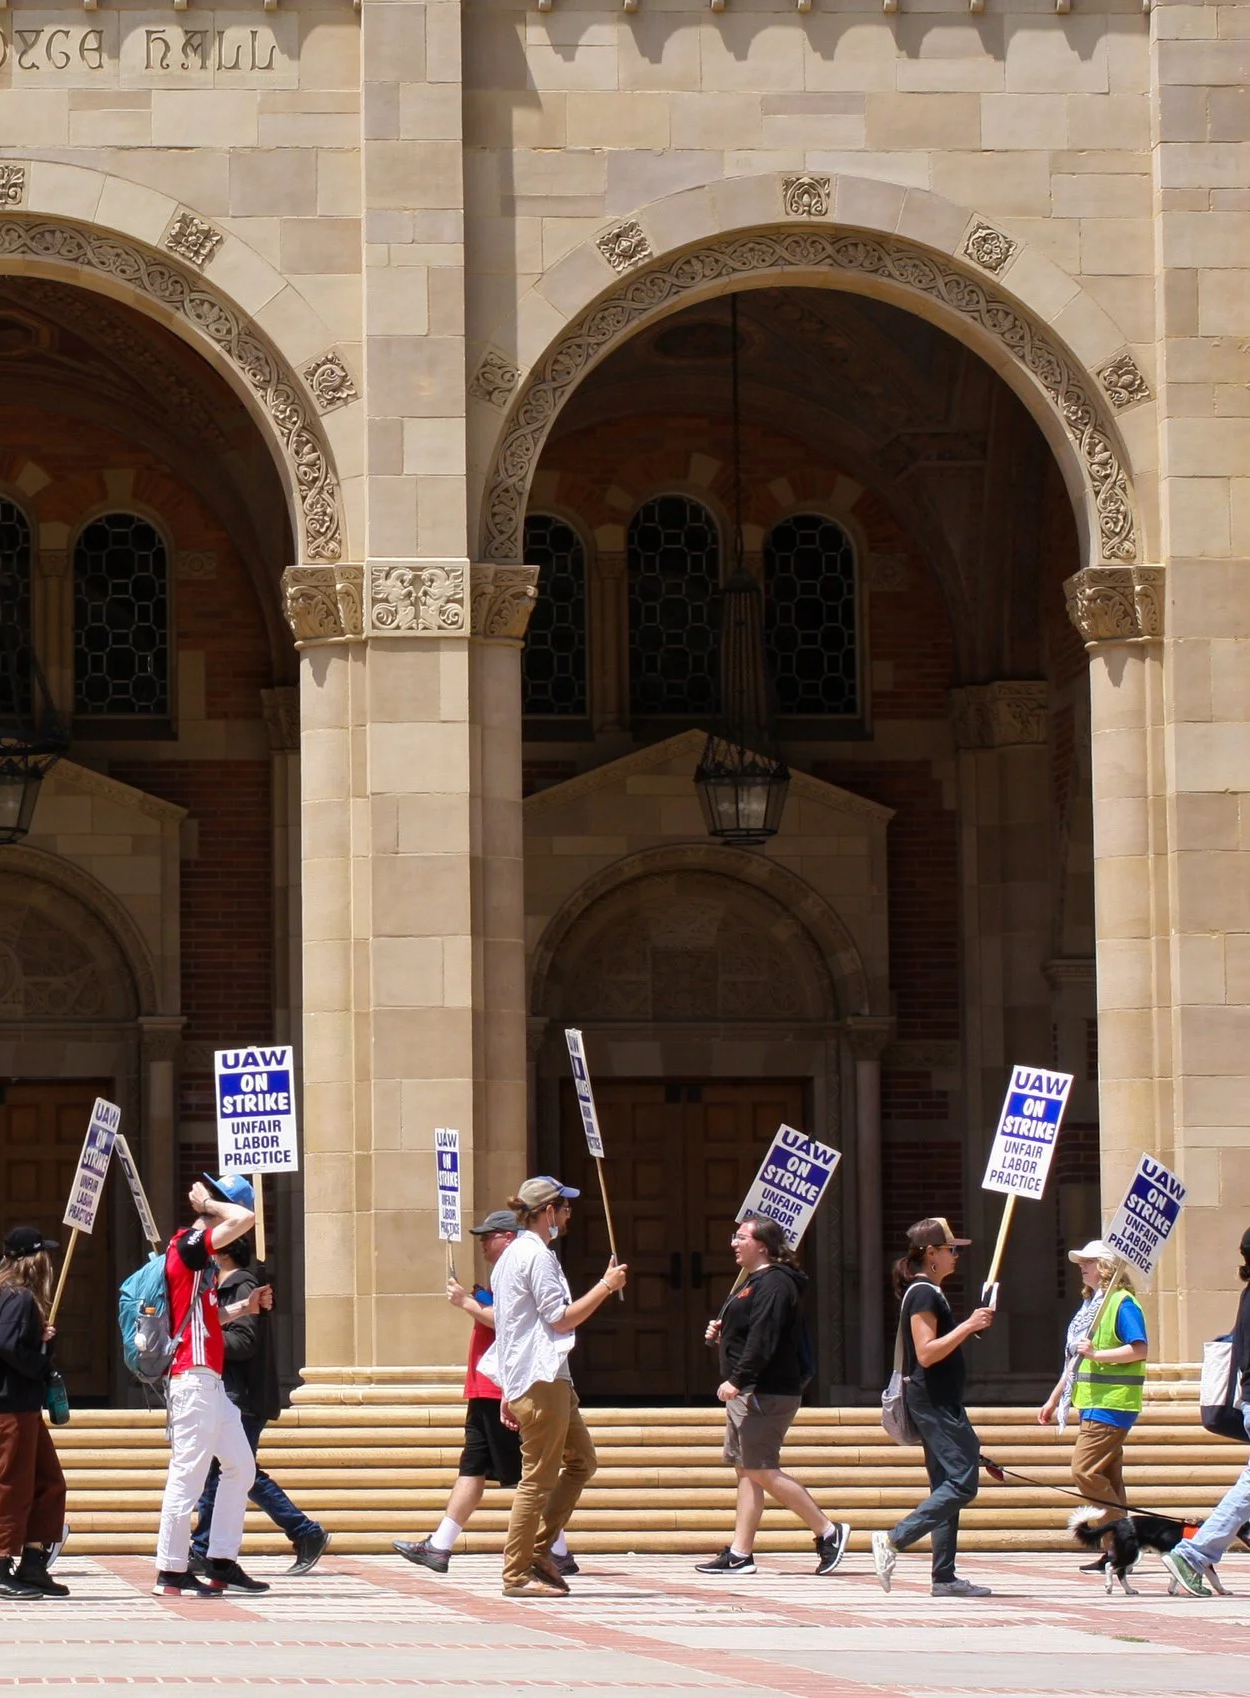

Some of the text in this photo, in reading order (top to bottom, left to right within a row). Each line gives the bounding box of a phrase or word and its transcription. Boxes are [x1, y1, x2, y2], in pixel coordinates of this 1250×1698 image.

[143, 26, 277, 71] HALL
[222, 1049, 287, 1069] UAW
[240, 1072, 268, 1093] ON
[1014, 1070, 1069, 1097] UAW
[95, 1102, 119, 1128] UAW
[222, 1092, 289, 1114] STRIKE
[1022, 1098, 1046, 1118] ON
[231, 1119, 282, 1135] UNFAIR
[1002, 1115, 1056, 1141] STRIKE
[95, 1129, 108, 1150] ON
[234, 1135, 280, 1151] LABOR
[436, 1132, 458, 1148] UAW
[781, 1129, 837, 1166] UAW
[1003, 1139, 1044, 1160] UNFAIR
[83, 1147, 109, 1174] STRIKE
[224, 1149, 291, 1166] PRACTICE
[442, 1152, 452, 1170] ON
[786, 1156, 812, 1178] ON
[1001, 1156, 1038, 1174] LABOR
[763, 1164, 820, 1201] STRIKE
[989, 1169, 1042, 1192] PRACTICE
[1141, 1158, 1186, 1201] UAW
[761, 1187, 803, 1216] UNFAIR
[1147, 1187, 1168, 1211] ON
[757, 1201, 795, 1227] LABOR
[1127, 1193, 1172, 1236] STRIKE
[1121, 1226, 1152, 1257] LABOR
[1125, 1214, 1159, 1247] UNFAIR
[1108, 1232, 1153, 1274] PRACTICE
